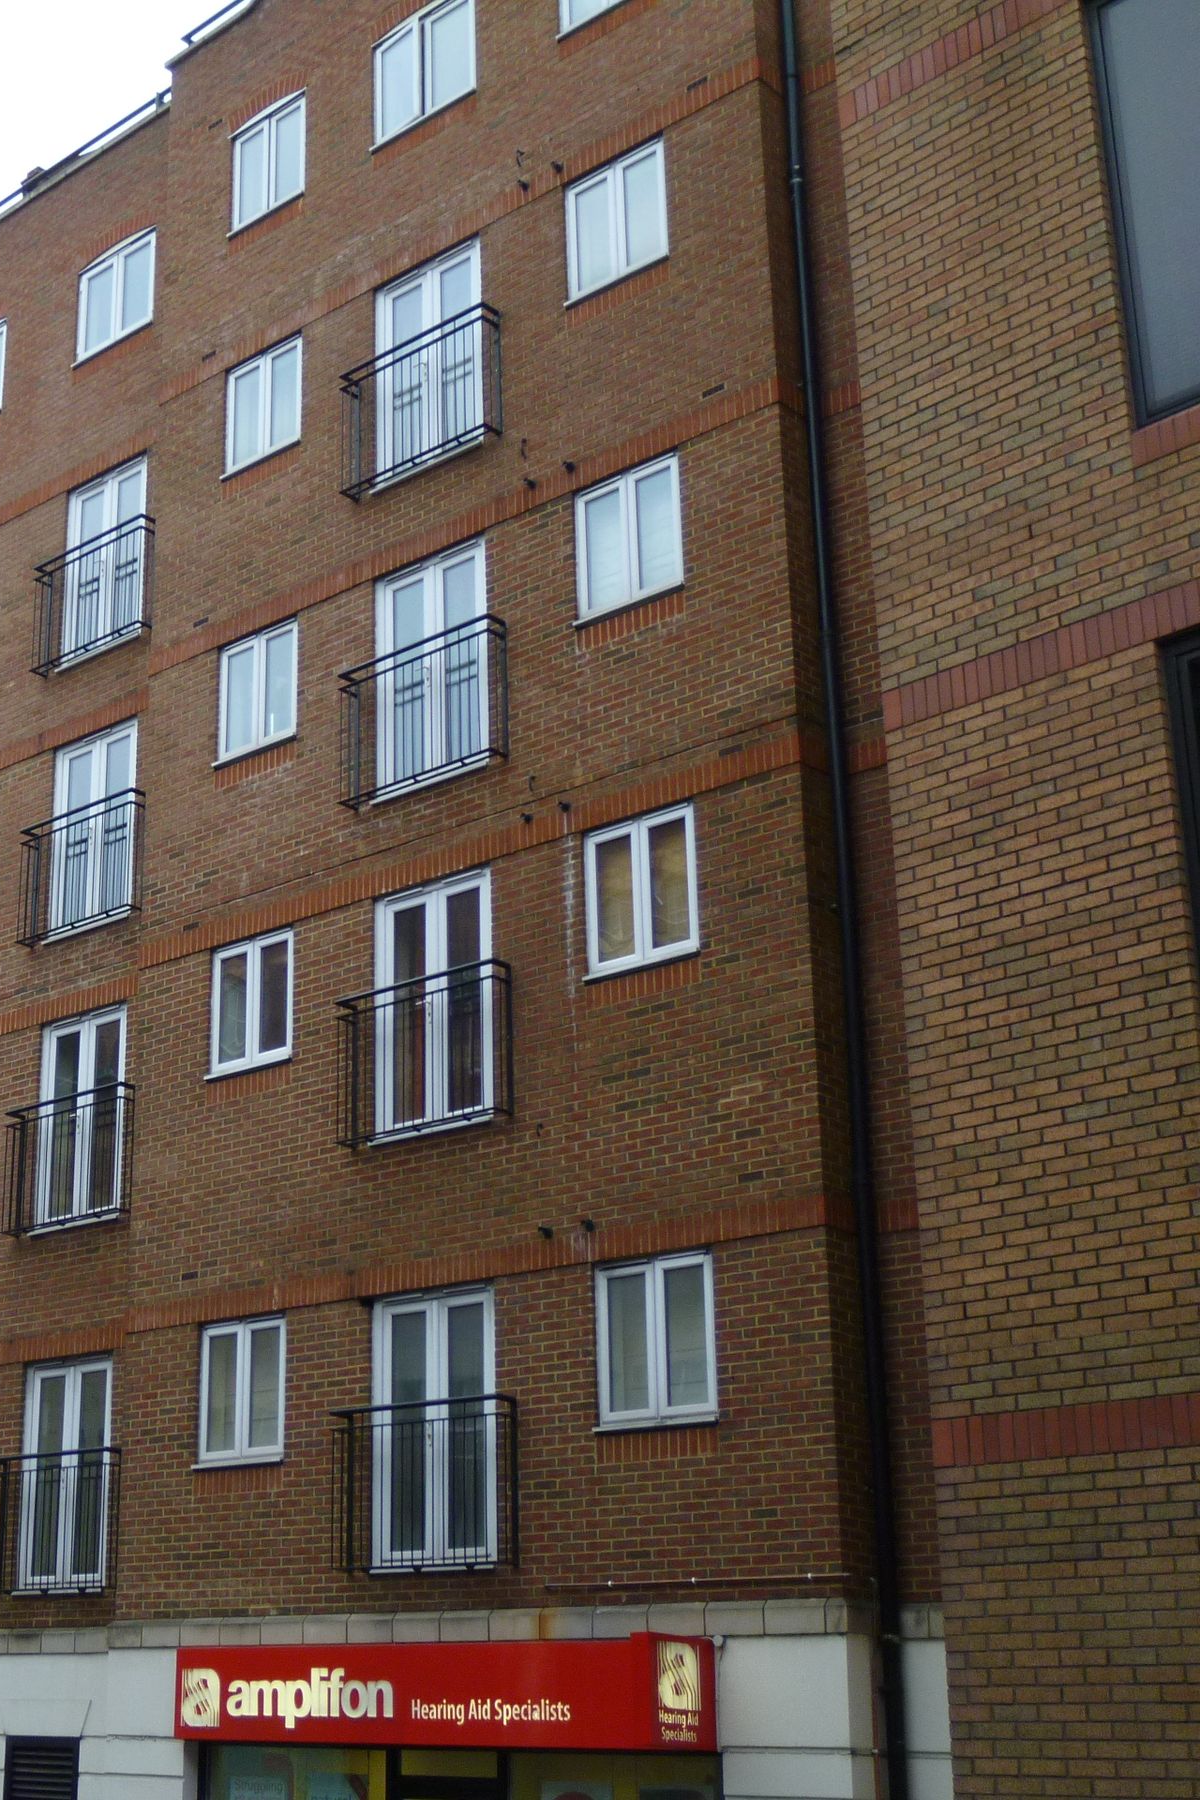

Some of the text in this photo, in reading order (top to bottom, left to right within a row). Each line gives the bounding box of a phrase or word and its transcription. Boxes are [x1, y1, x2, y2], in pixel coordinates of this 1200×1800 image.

[226, 1667, 394, 1729] amplifon
[411, 1698, 571, 1726] Hearing Aid Specialists
[659, 1709, 699, 1728] Hearing Aid
[661, 1726, 697, 1743] Specialists
